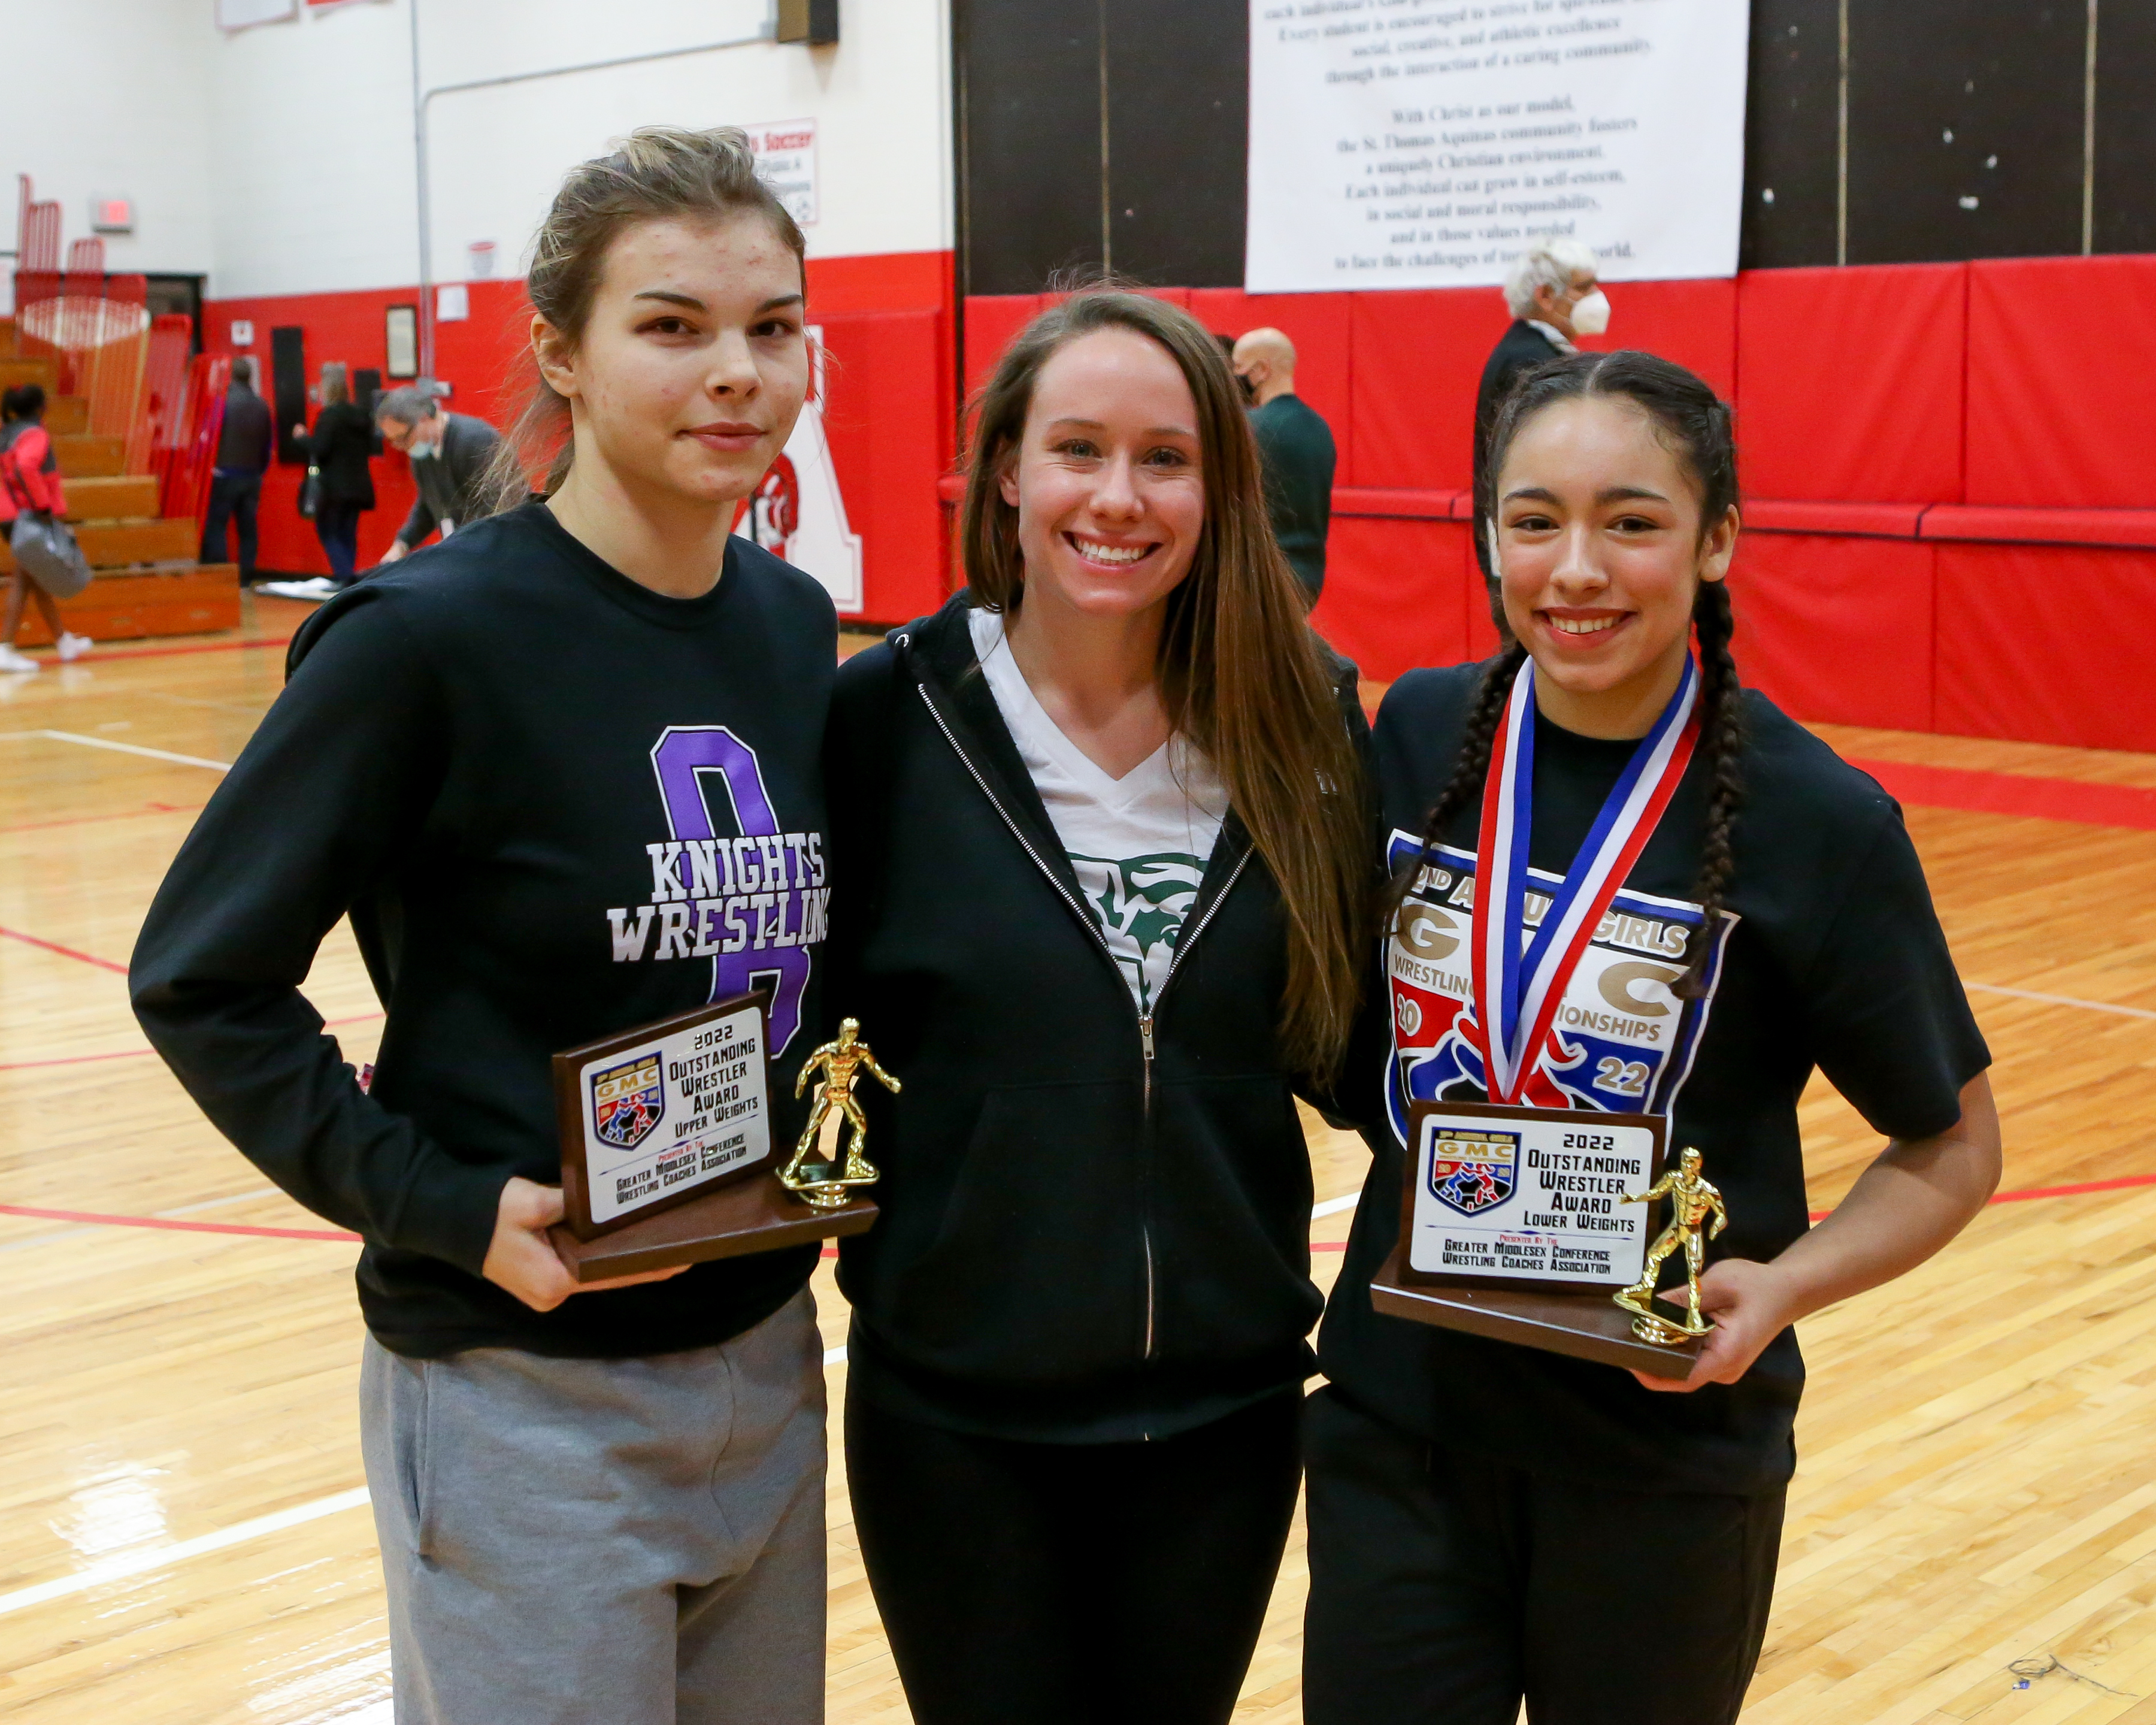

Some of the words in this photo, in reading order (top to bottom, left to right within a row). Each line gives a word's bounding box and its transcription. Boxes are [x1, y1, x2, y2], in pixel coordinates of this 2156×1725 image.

[1388, 5, 1466, 28] encouraged
[1546, 17, 1620, 35] excellence
[1325, 66, 1373, 84] through
[1380, 65, 1400, 77] the
[1404, 58, 1479, 76] interaction
[1392, 108, 1424, 123] With
[1429, 104, 1473, 120] Christ
[1385, 134, 1435, 148] Thomas
[1442, 130, 1495, 147] Aquinas
[1501, 122, 1582, 140] community
[1438, 152, 1504, 168] Christian
[1383, 178, 1452, 196] individual
[1385, 204, 1422, 219] social
[1428, 203, 1451, 218] and
[1408, 250, 1477, 268] challenges
[646, 833, 825, 903] KNIGHTS
[1594, 910, 1690, 958] GIRLS
[1397, 992, 1423, 1037] 20
[694, 1025, 733, 1050] 2022
[598, 1068, 658, 1097] GMC
[1593, 1056, 1649, 1097] 22
[1438, 1142, 1512, 1158] GMC
[1563, 1134, 1615, 1151] 2022
